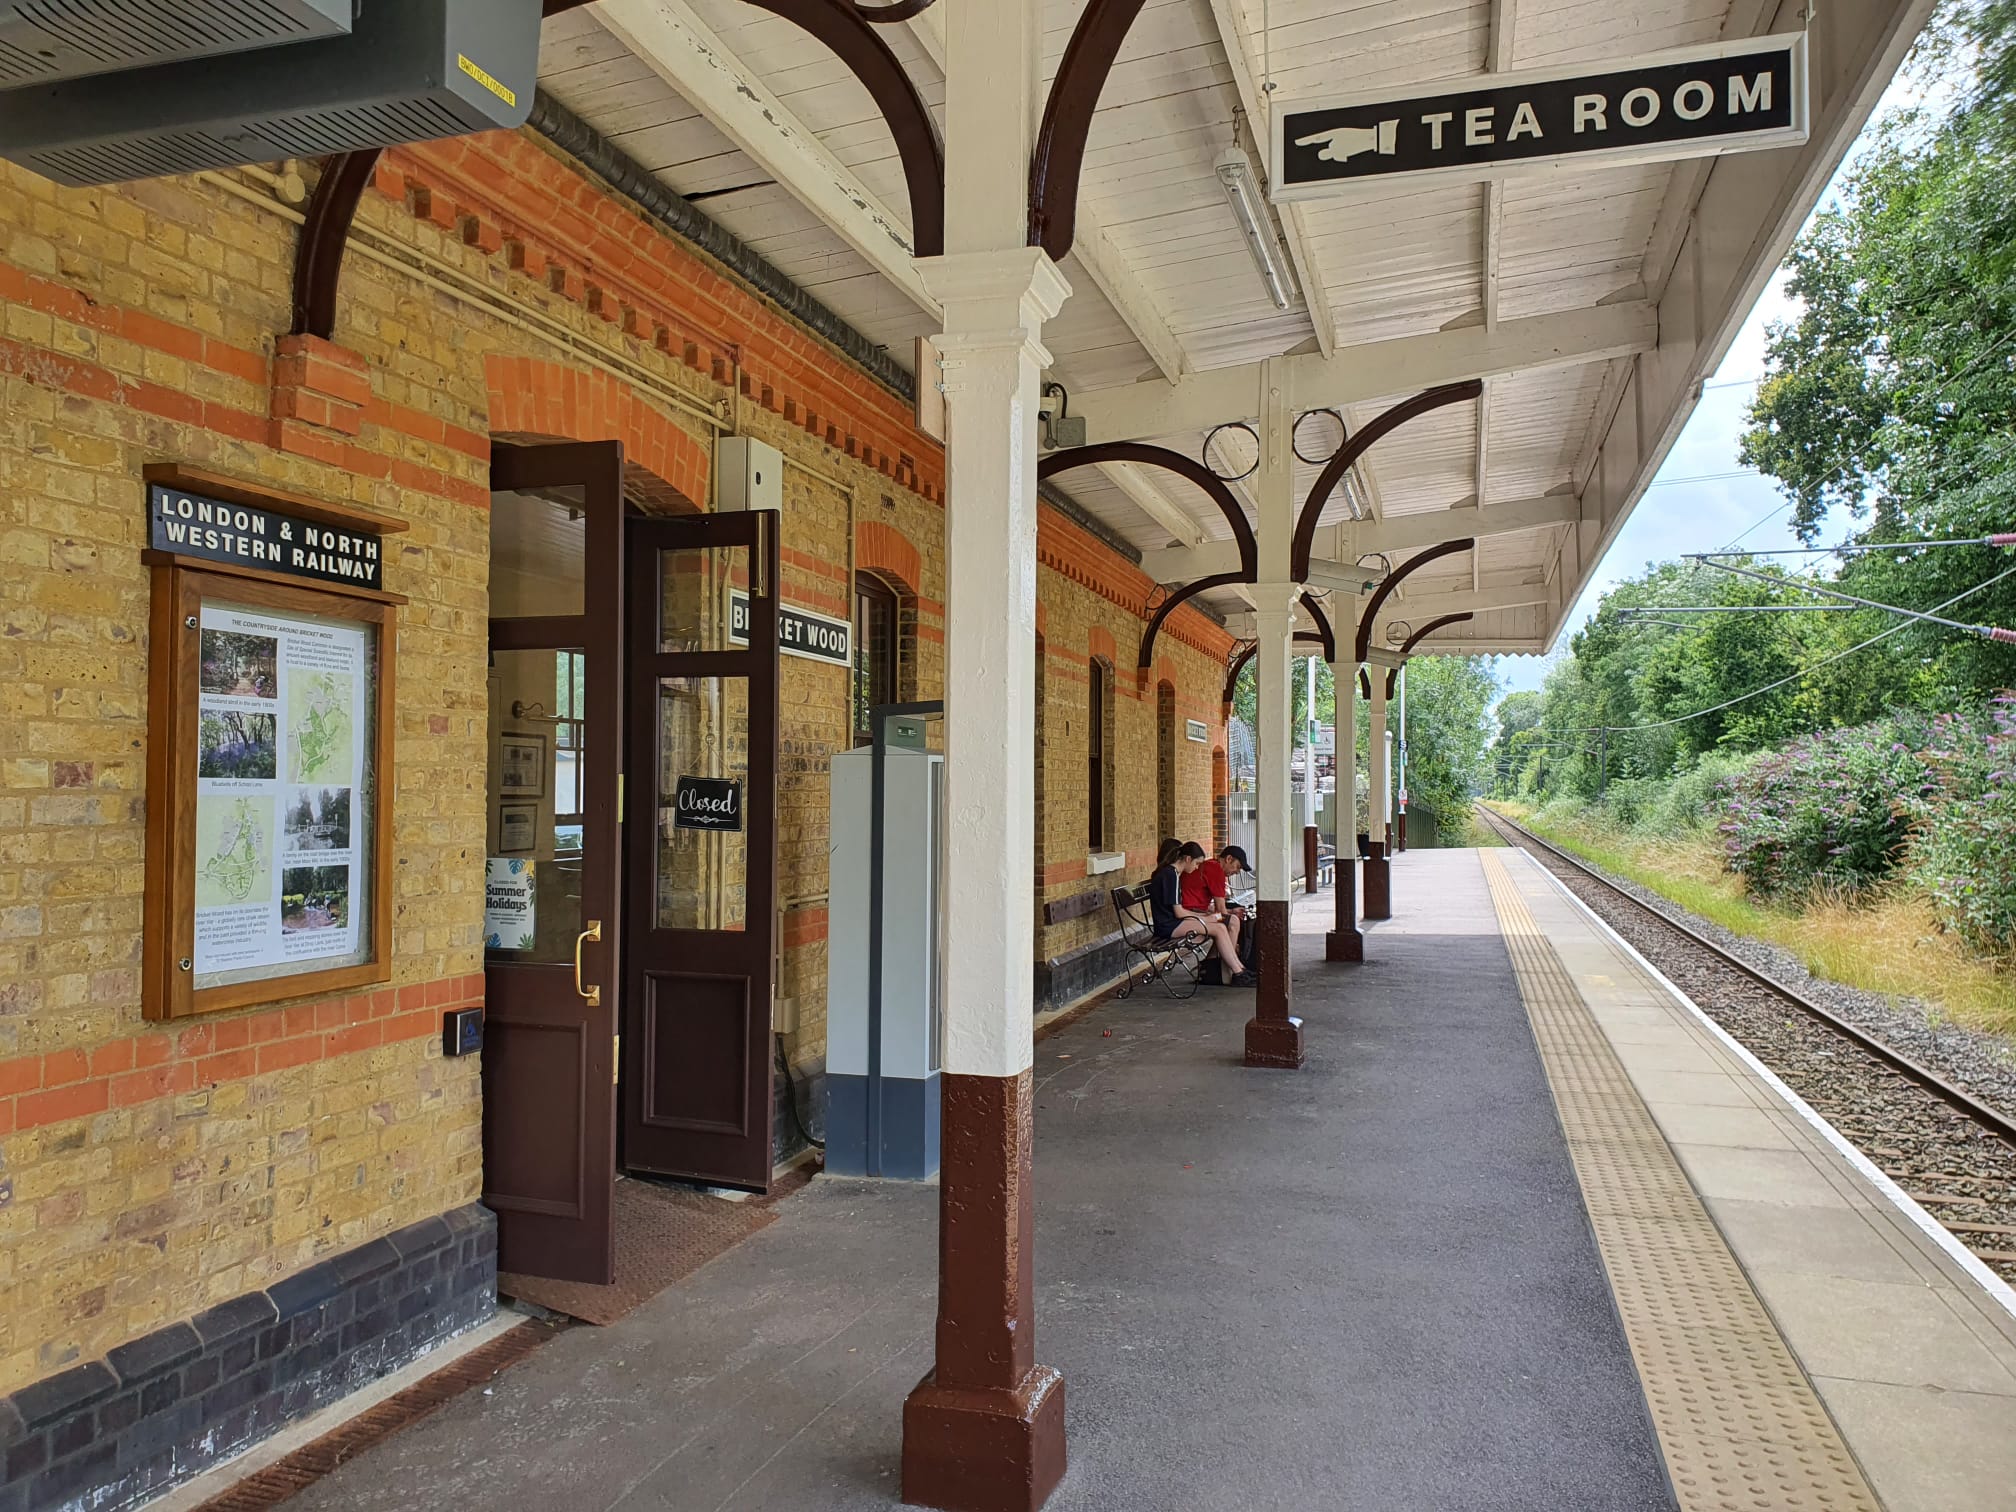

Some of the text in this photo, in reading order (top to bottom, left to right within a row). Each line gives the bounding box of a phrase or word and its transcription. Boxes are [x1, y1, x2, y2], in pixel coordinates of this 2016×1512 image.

[1421, 71, 1773, 151] TEA ROOM
[161, 494, 378, 560] LONDON & NORTH
[166, 521, 376, 581] WESTERN RAILWAY
[243, 621, 278, 632] COUNTRYSIDE
[807, 623, 847, 653] WOOD
[679, 788, 737, 815] Closed
[486, 884, 526, 896] Summer
[486, 897, 527, 912] Holidays
